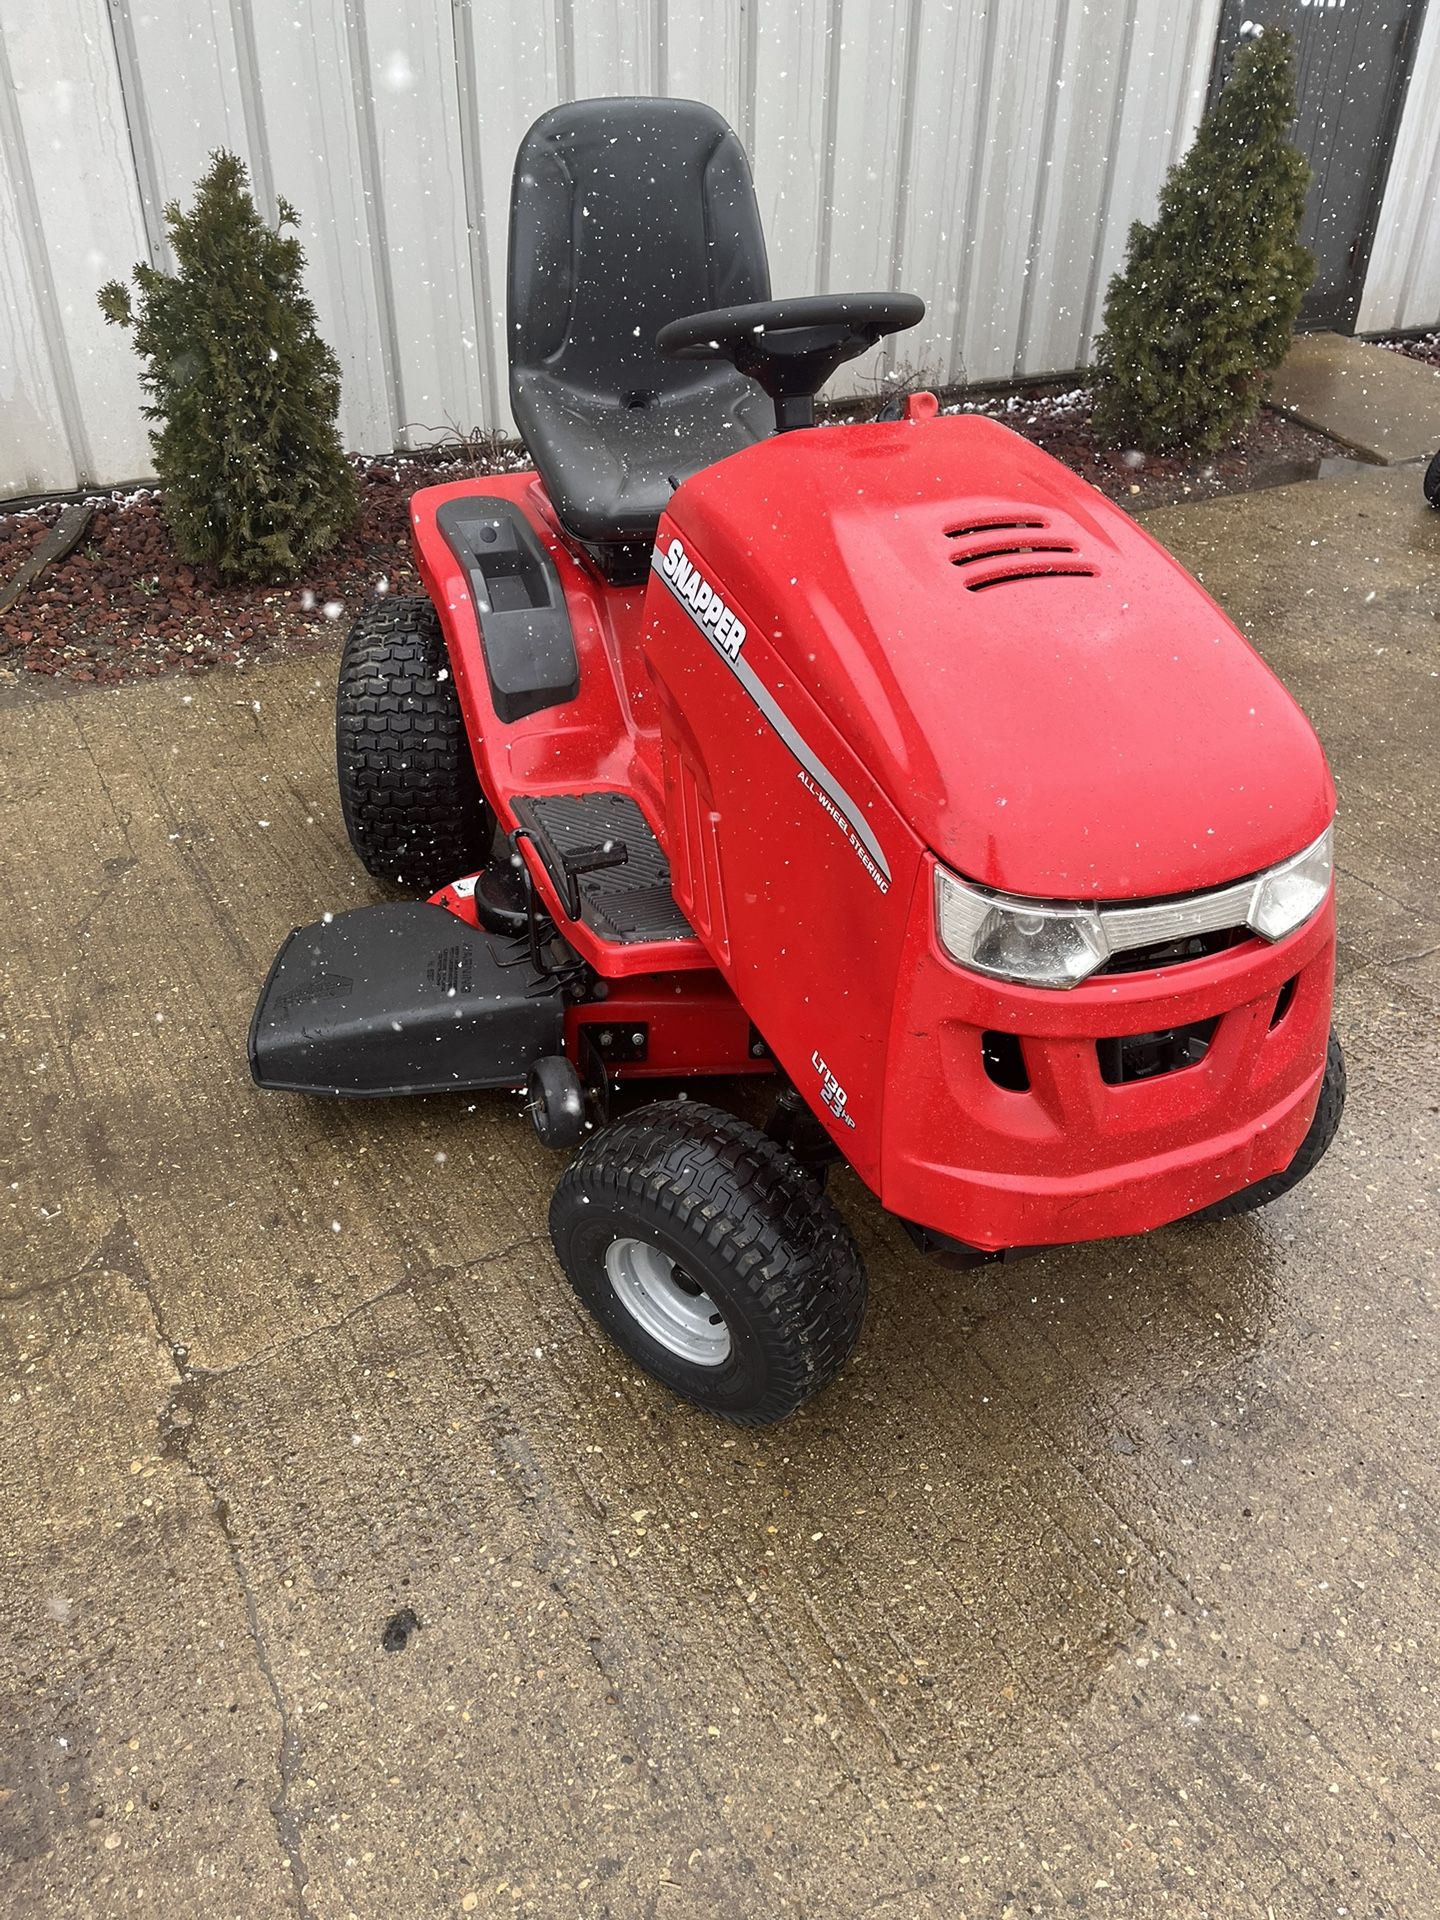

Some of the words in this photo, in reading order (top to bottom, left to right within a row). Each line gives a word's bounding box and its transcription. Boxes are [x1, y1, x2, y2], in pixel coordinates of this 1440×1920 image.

[662, 538, 747, 663] SNAPPER
[797, 770, 849, 836] ALL-WHEEL
[848, 833, 889, 895] STEERING
[811, 1049, 848, 1106] LT130
